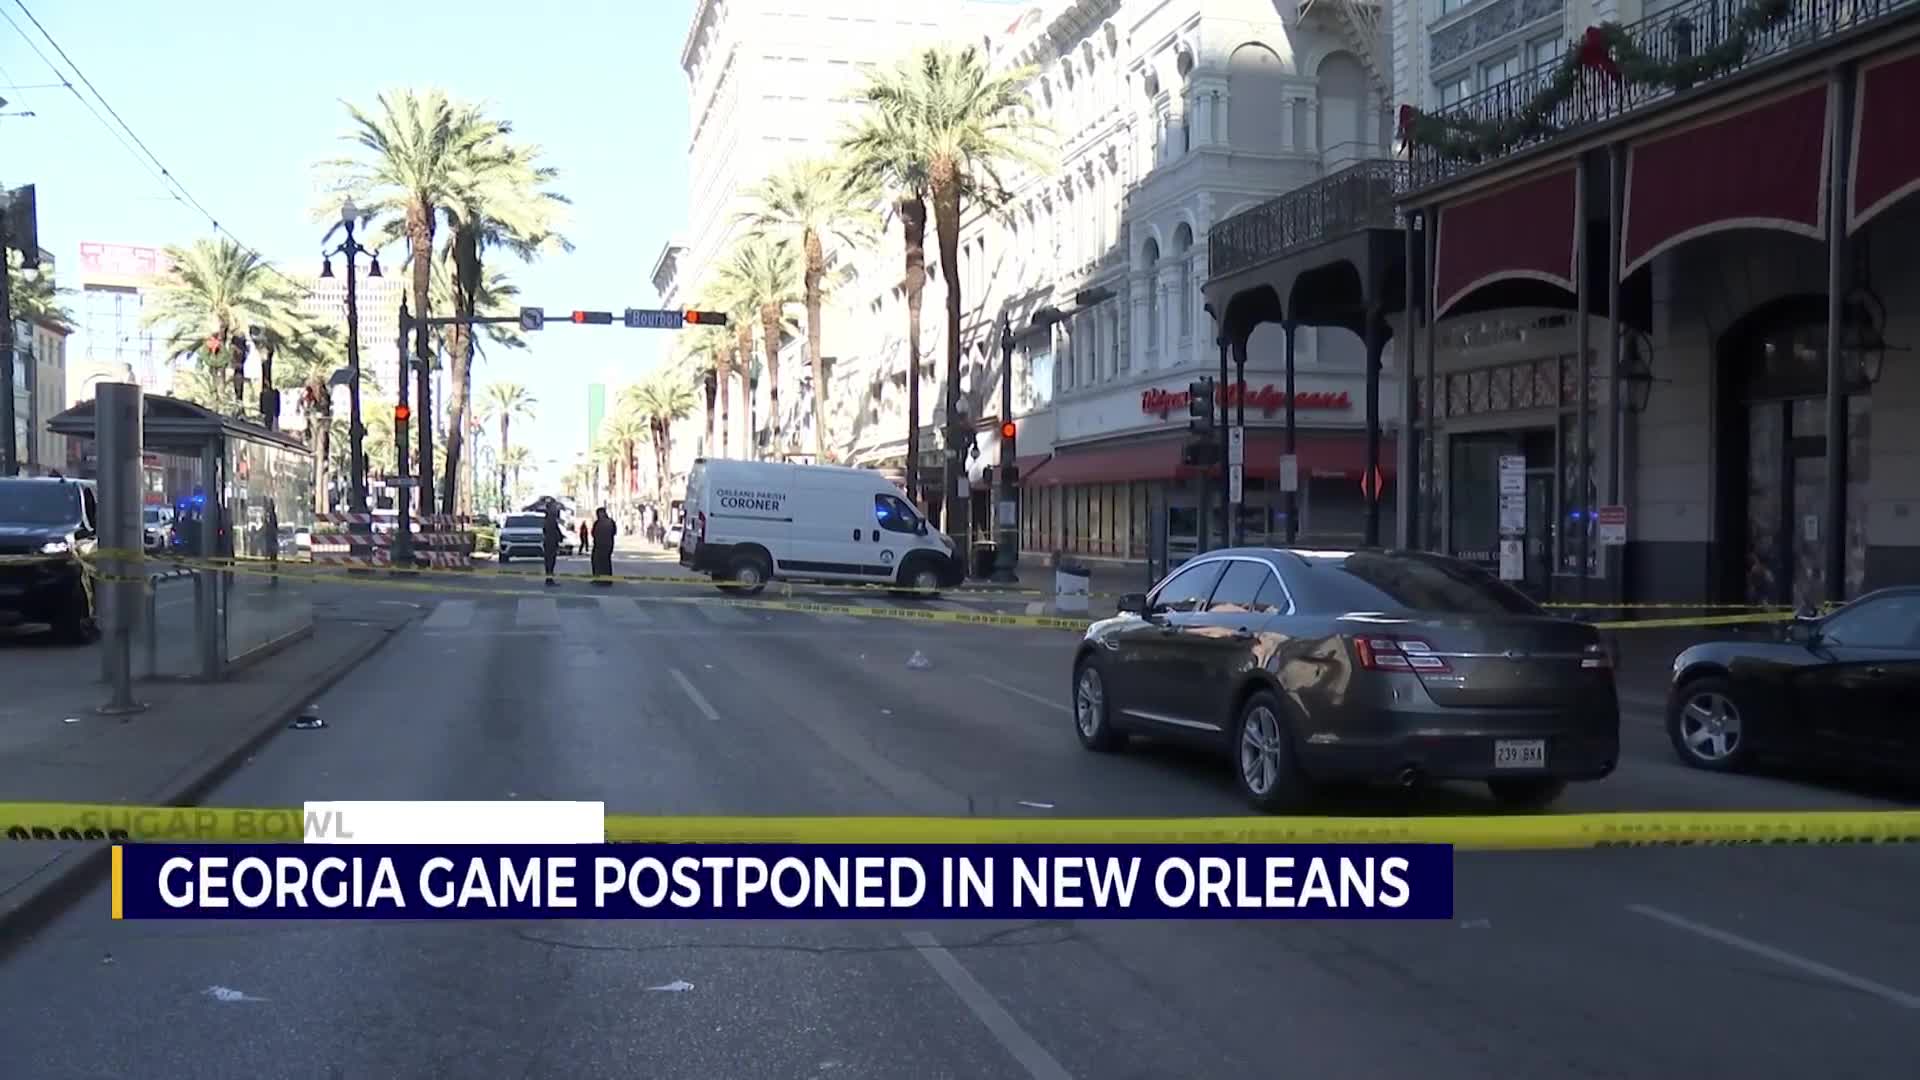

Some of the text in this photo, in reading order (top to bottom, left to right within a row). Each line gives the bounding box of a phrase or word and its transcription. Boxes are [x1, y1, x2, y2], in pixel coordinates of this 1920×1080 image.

[632, 311, 682, 326] Bourbon
[716, 488, 787, 503] ORLEANS PARISH
[720, 496, 780, 511] CORONER
[1498, 747, 1518, 761] 239
